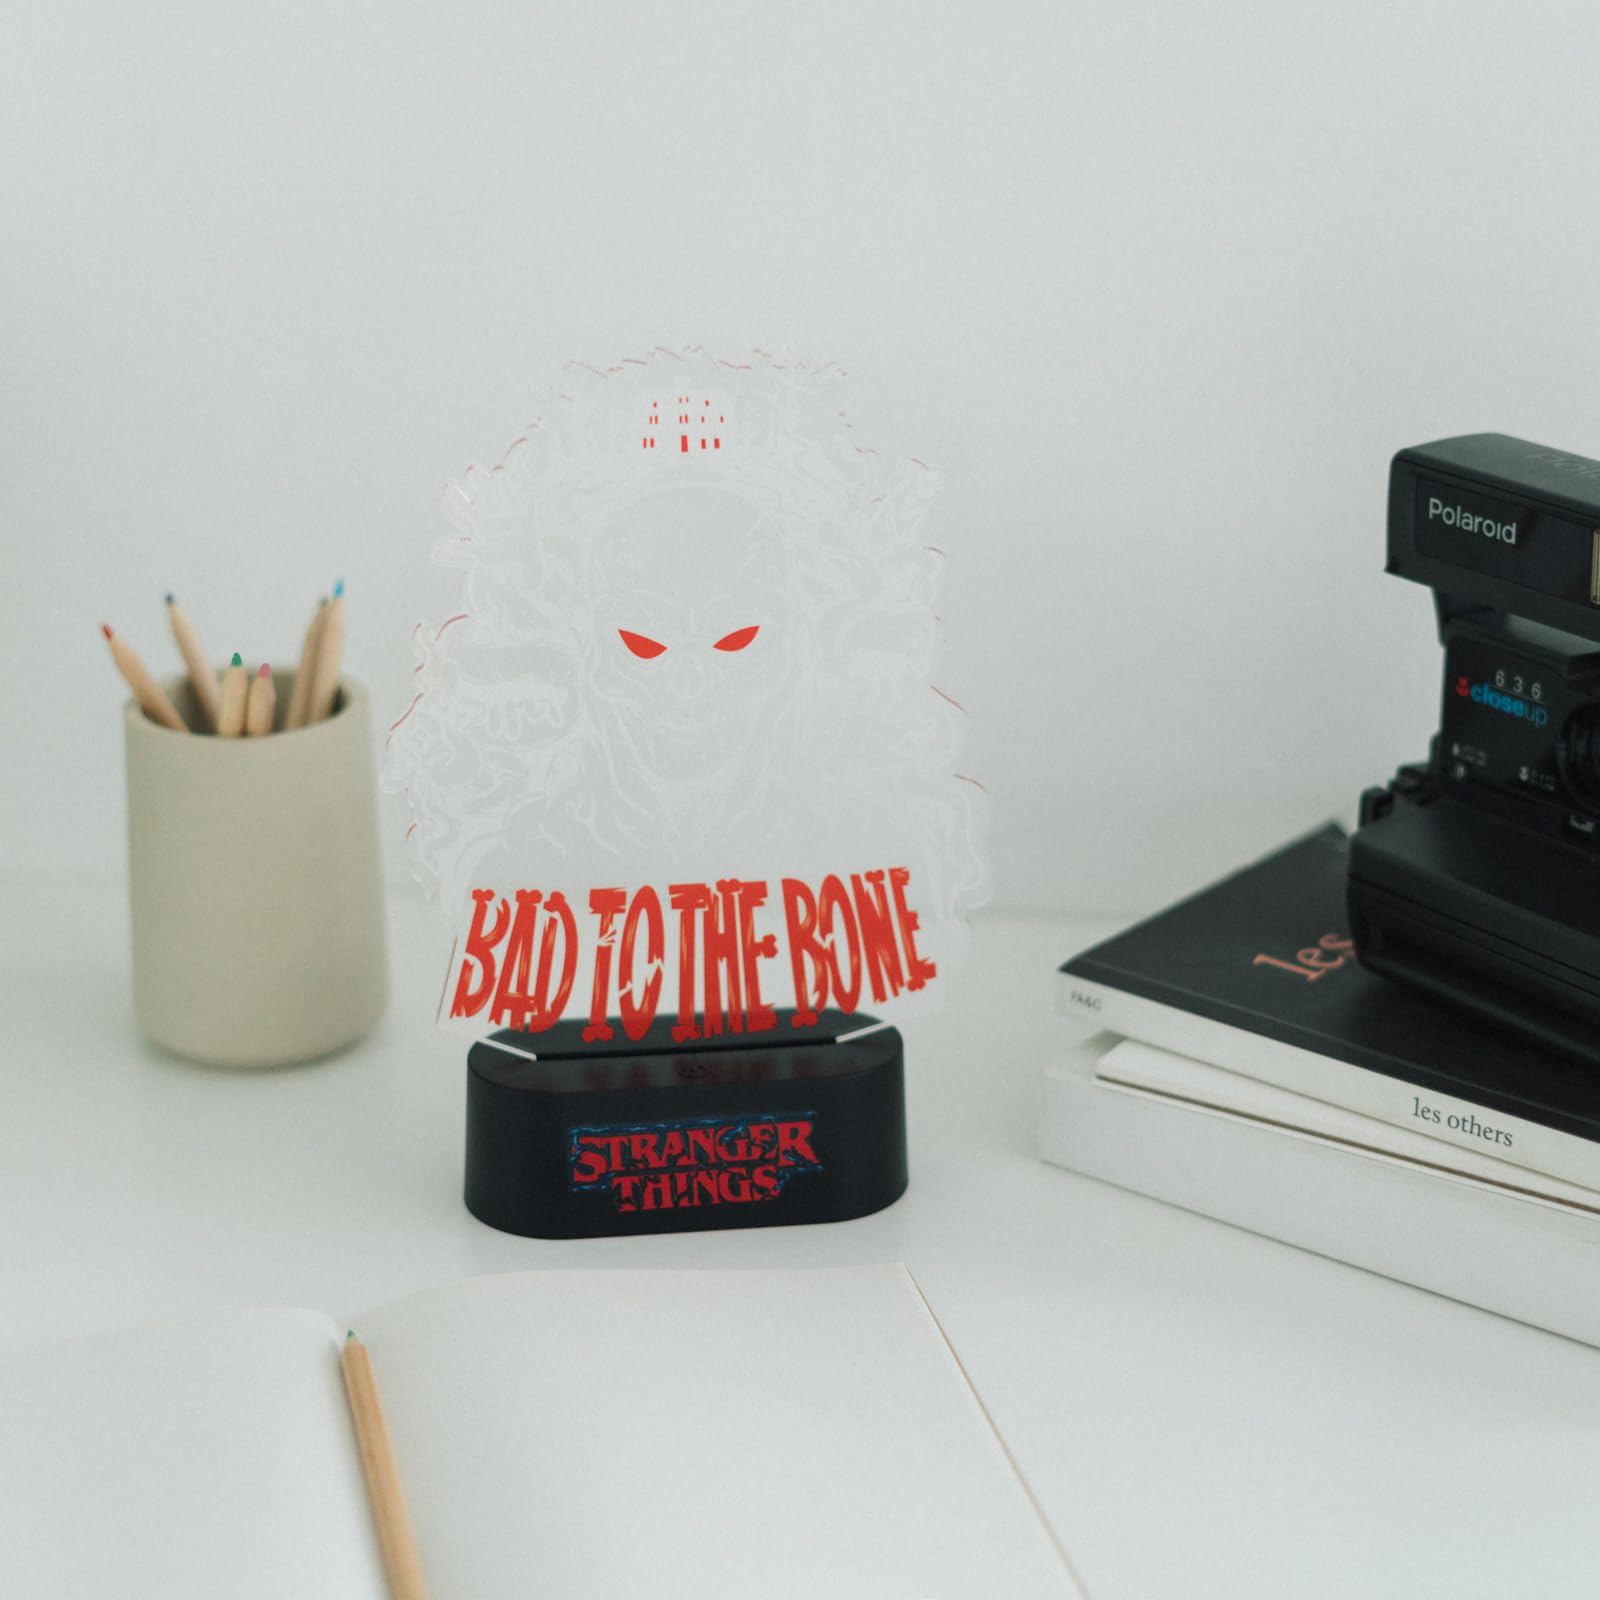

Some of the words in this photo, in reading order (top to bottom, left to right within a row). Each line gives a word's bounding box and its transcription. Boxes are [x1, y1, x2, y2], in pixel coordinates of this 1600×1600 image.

[1428, 496, 1517, 545] Polaroid
[1470, 683, 1550, 727] closeup
[448, 887, 580, 1035] BAD
[581, 884, 666, 1044] TO
[667, 877, 779, 1044] THE
[780, 866, 938, 1029] BONE
[1412, 1096, 1441, 1124] les
[1447, 1114, 1513, 1147] others
[570, 1119, 821, 1184] STRANGER
[611, 1162, 783, 1214] THINGS
